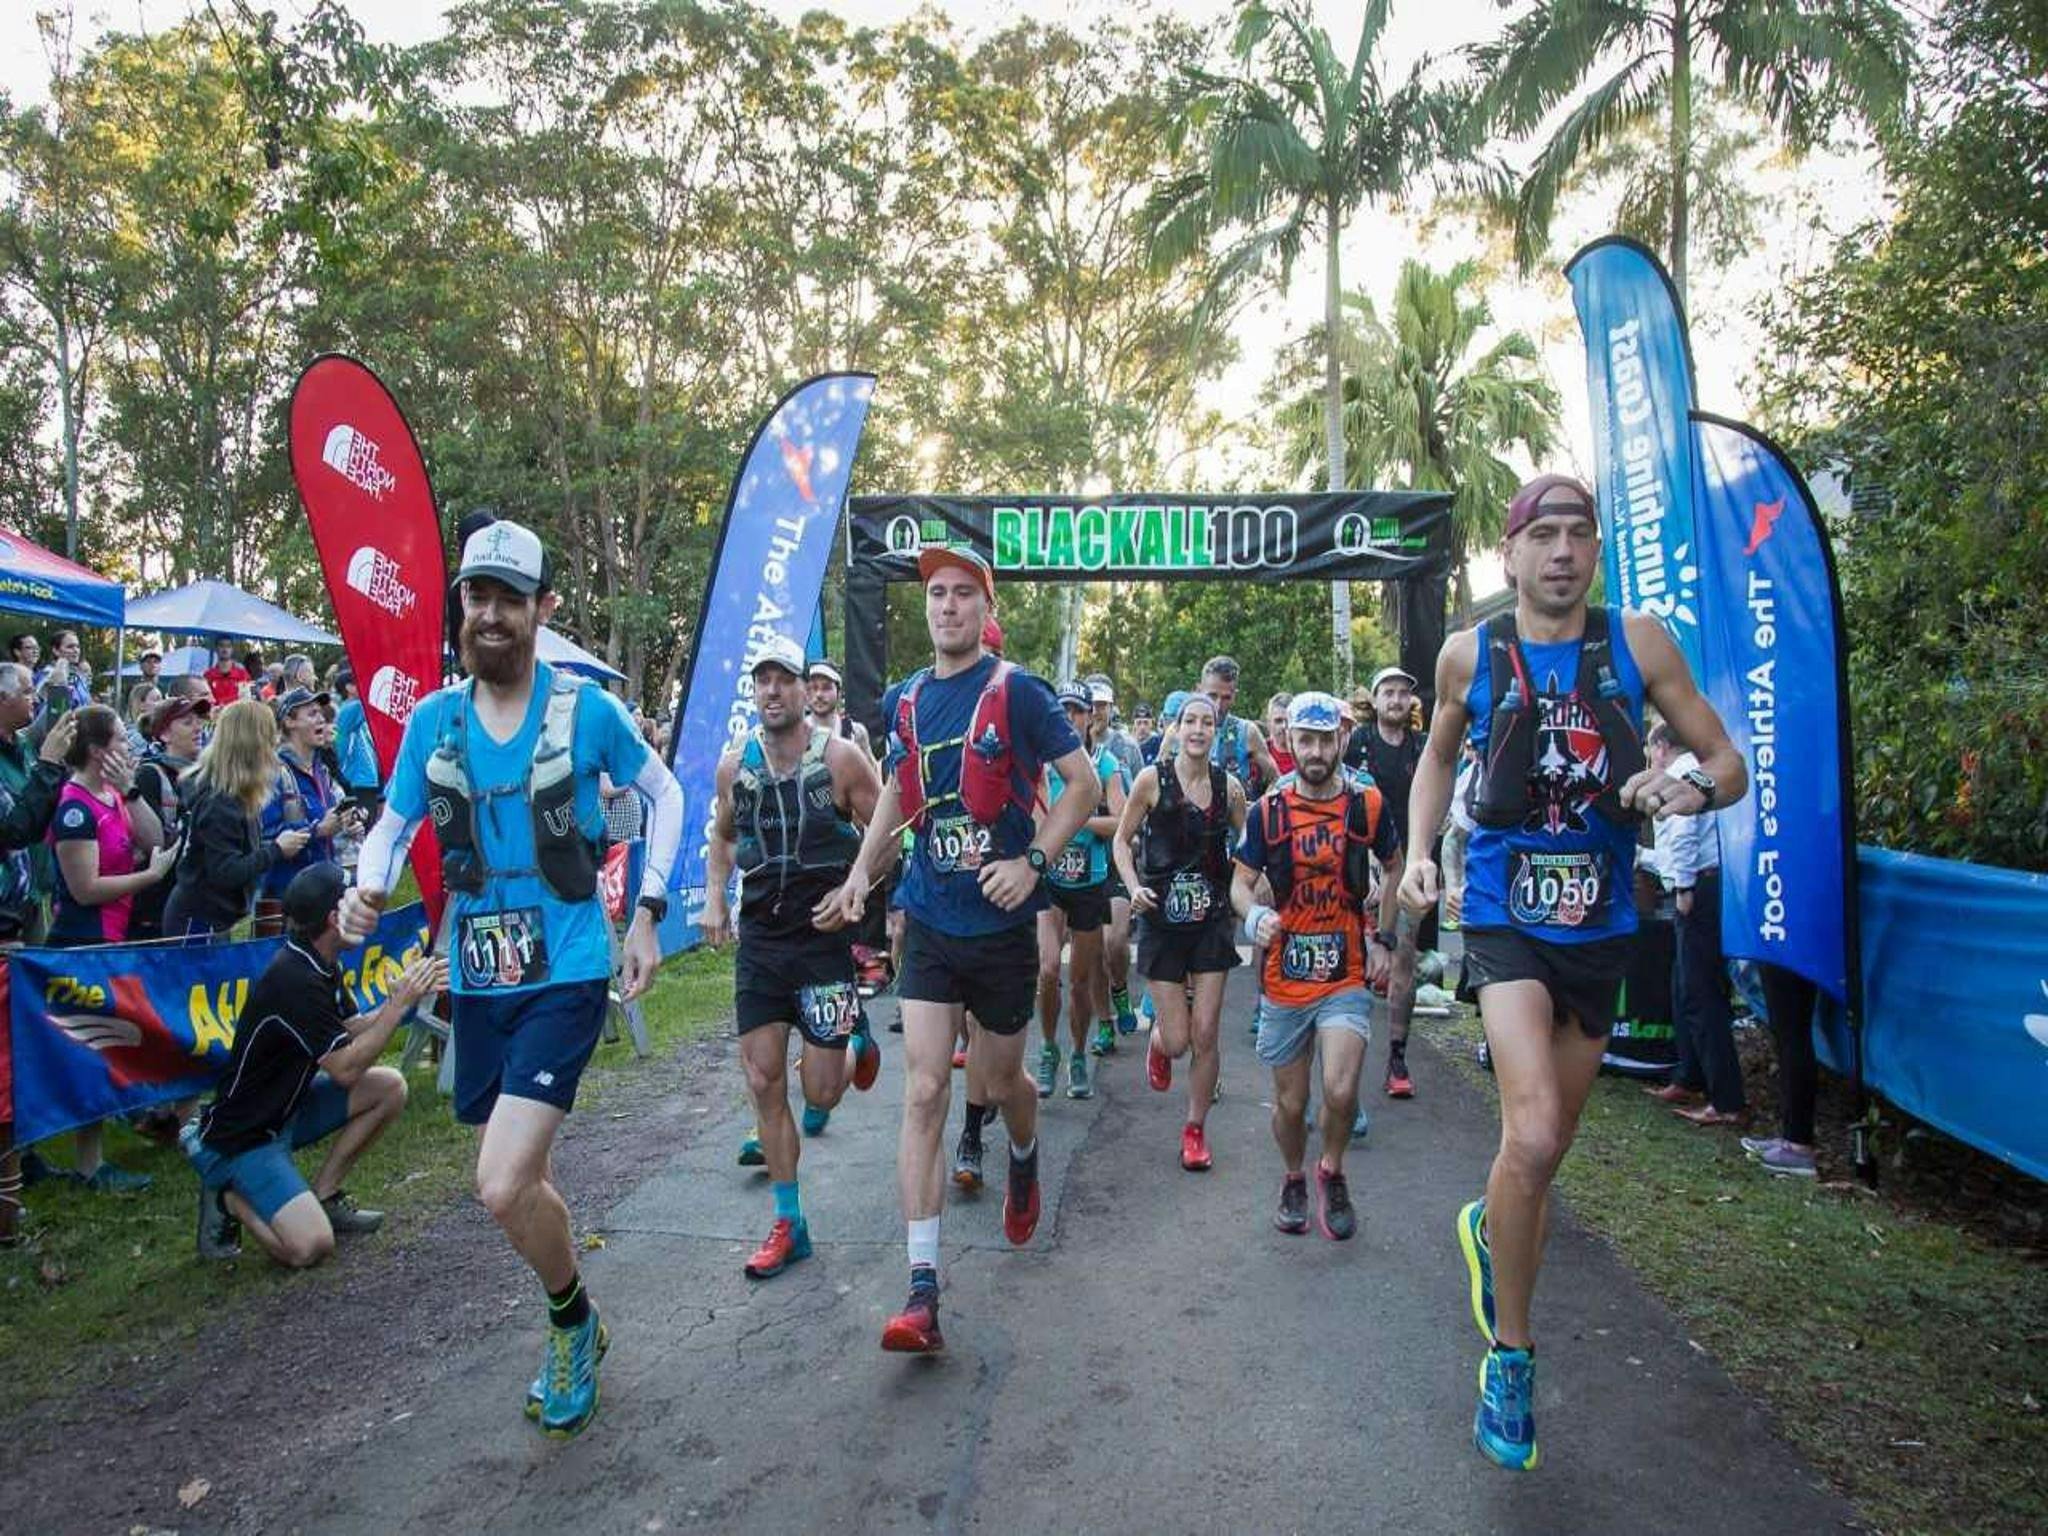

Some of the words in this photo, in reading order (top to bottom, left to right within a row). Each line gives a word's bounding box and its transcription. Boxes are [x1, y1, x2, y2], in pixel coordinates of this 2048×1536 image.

[763, 515, 807, 586] The
[933, 829, 992, 859] 1042
[1521, 876, 1600, 906] 1050
[1288, 948, 1339, 970] 1153
[46, 976, 106, 1009] The
[811, 997, 860, 1025] 1074
